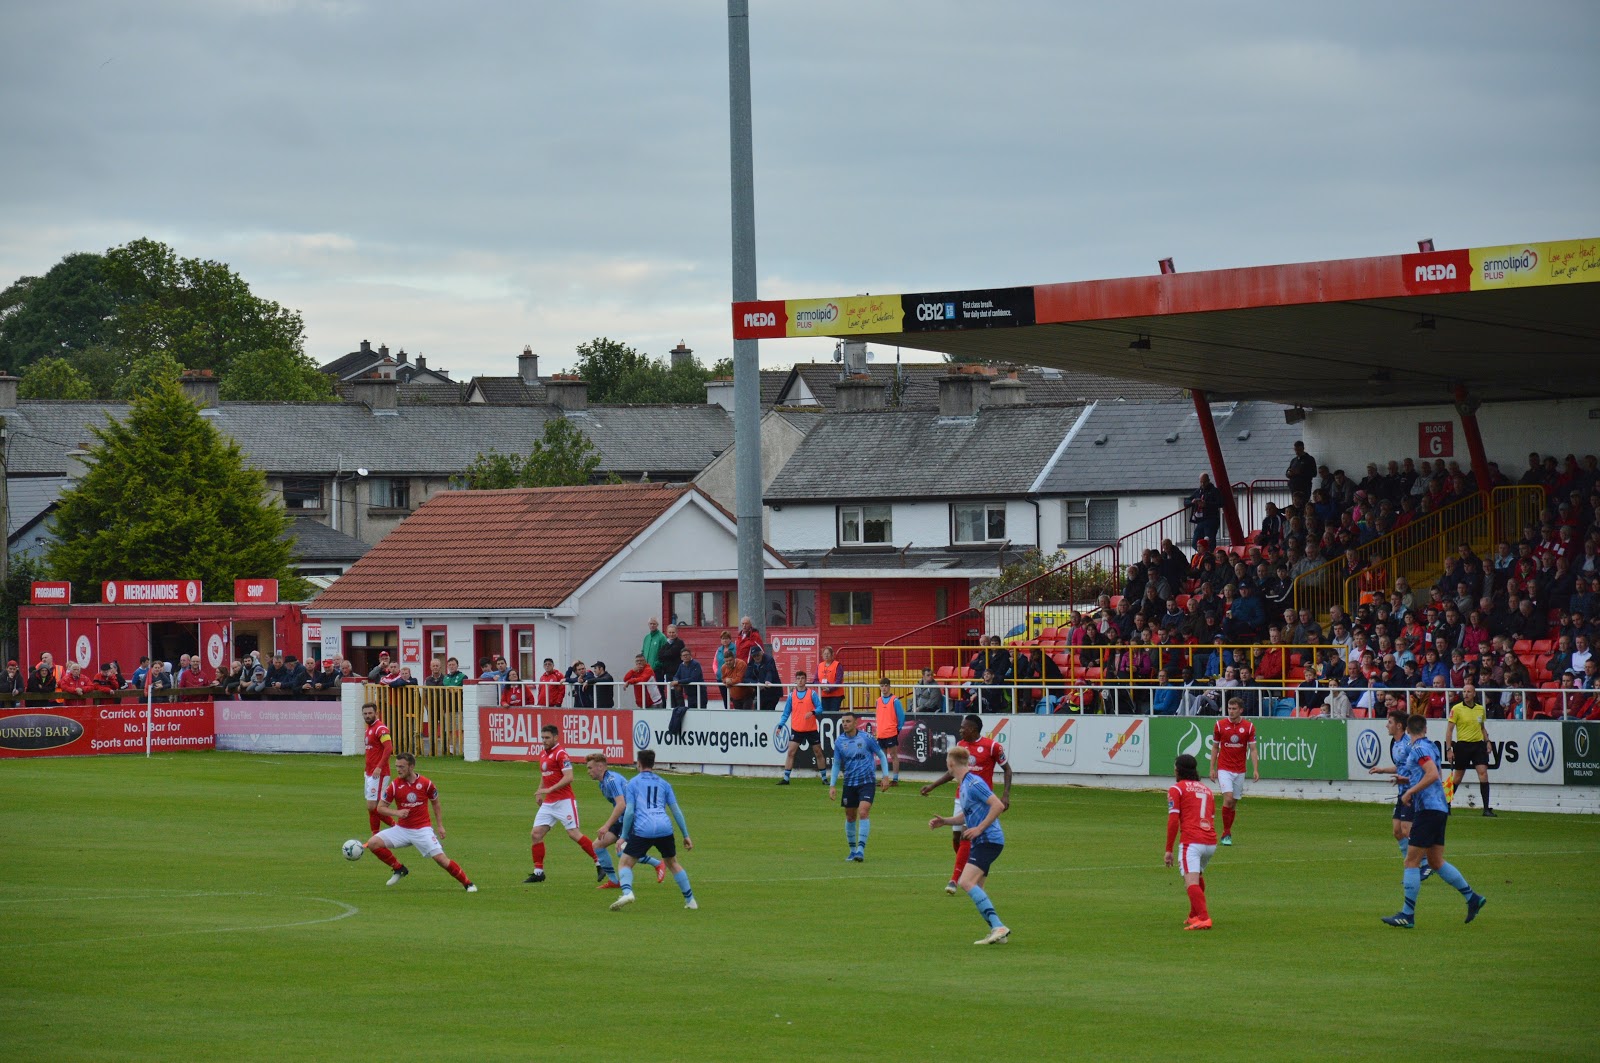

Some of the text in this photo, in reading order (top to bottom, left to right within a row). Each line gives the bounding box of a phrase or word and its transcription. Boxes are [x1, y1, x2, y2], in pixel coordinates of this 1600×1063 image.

[1484, 255, 1529, 272] armolipid
[1415, 263, 1457, 282] MEDA
[1484, 271, 1504, 280] PLUS
[796, 309, 832, 323] armolipid
[916, 302, 944, 321] CB12
[743, 312, 776, 328] MEDA
[1425, 425, 1447, 434] BLOCK
[1430, 436, 1443, 455] G
[34, 587, 65, 598] PROGRAMMES
[124, 584, 179, 600] MERCHANDISE
[247, 585, 264, 597] SHOP
[308, 627, 321, 638] TOILE
[782, 637, 816, 646] SLIGO ROVERS
[100, 709, 136, 719] Carrick
[154, 707, 204, 718] Shannon's
[489, 713, 503, 727] OFF
[168, 722, 181, 731] for
[504, 714, 543, 743] BALL
[563, 715, 578, 729] OFF
[0, 726, 70, 738] UNNES BAR
[489, 727, 504, 742] THE
[563, 729, 579, 744] THE
[579, 715, 624, 745] BALL
[90, 738, 121, 750] Sports
[124, 737, 143, 747] and
[146, 735, 214, 746] ntertainment
[655, 724, 768, 753] volkswagen.ie
[1246, 735, 1317, 768] irtricity
[812, 757, 835, 765] SRT
[647, 786, 658, 809] 11
[1195, 792, 1207, 819] 7
